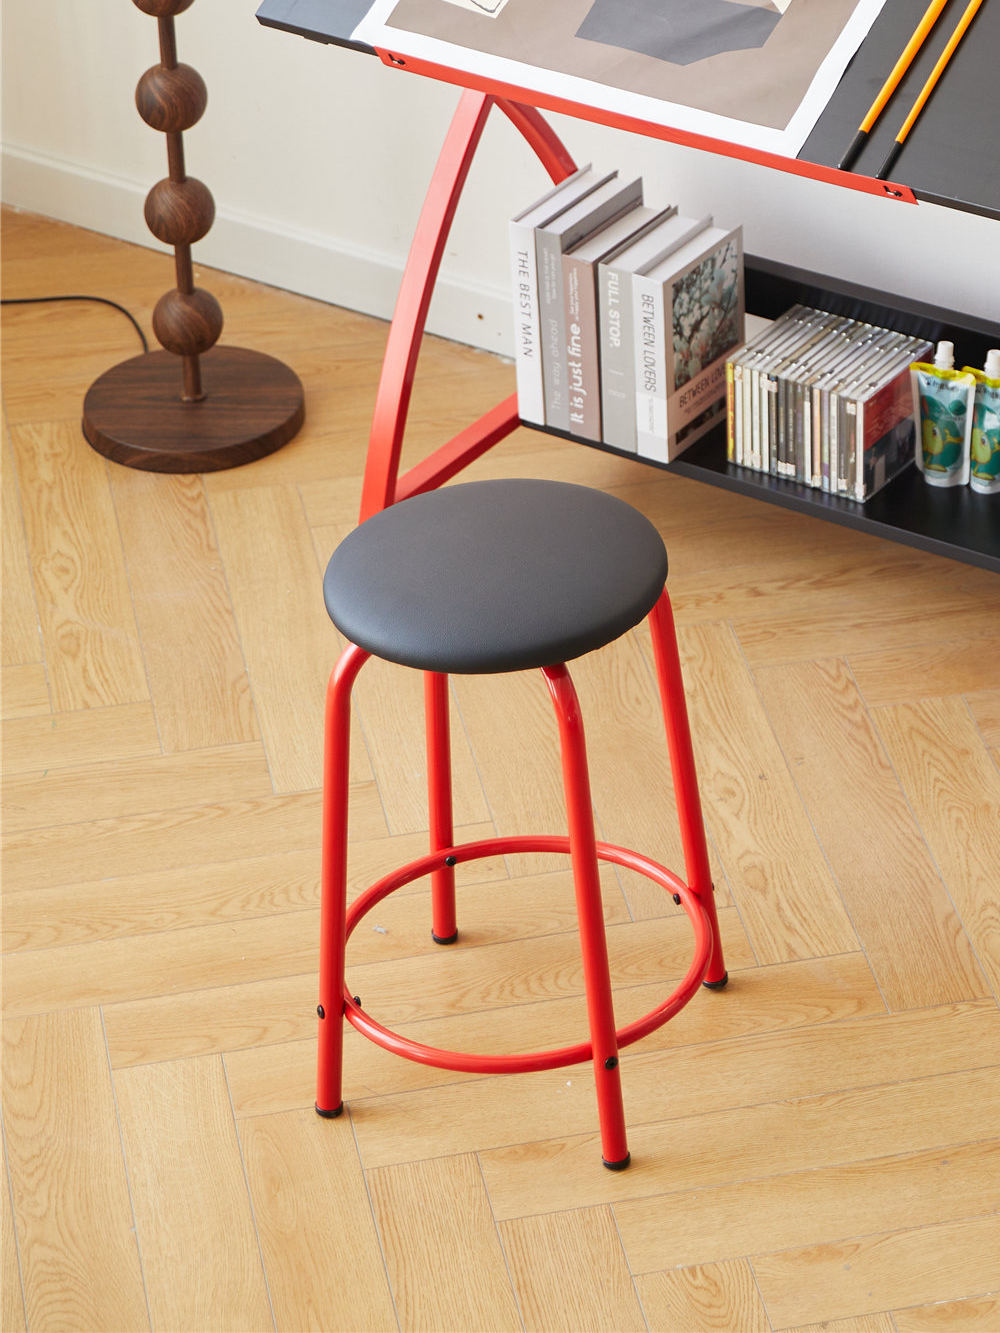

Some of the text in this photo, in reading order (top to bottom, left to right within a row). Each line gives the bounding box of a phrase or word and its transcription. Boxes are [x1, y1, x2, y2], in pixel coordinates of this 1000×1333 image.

[517, 251, 533, 358] THE BEST MAN
[607, 271, 621, 348] FULL STOP.
[641, 293, 656, 348] BETWEEN
[567, 323, 582, 357] fine
[567, 361, 588, 396] just
[643, 349, 657, 393] LOVERS
[569, 396, 584, 409] is
[679, 376, 710, 408] BETWEEN
[569, 412, 585, 424] It
